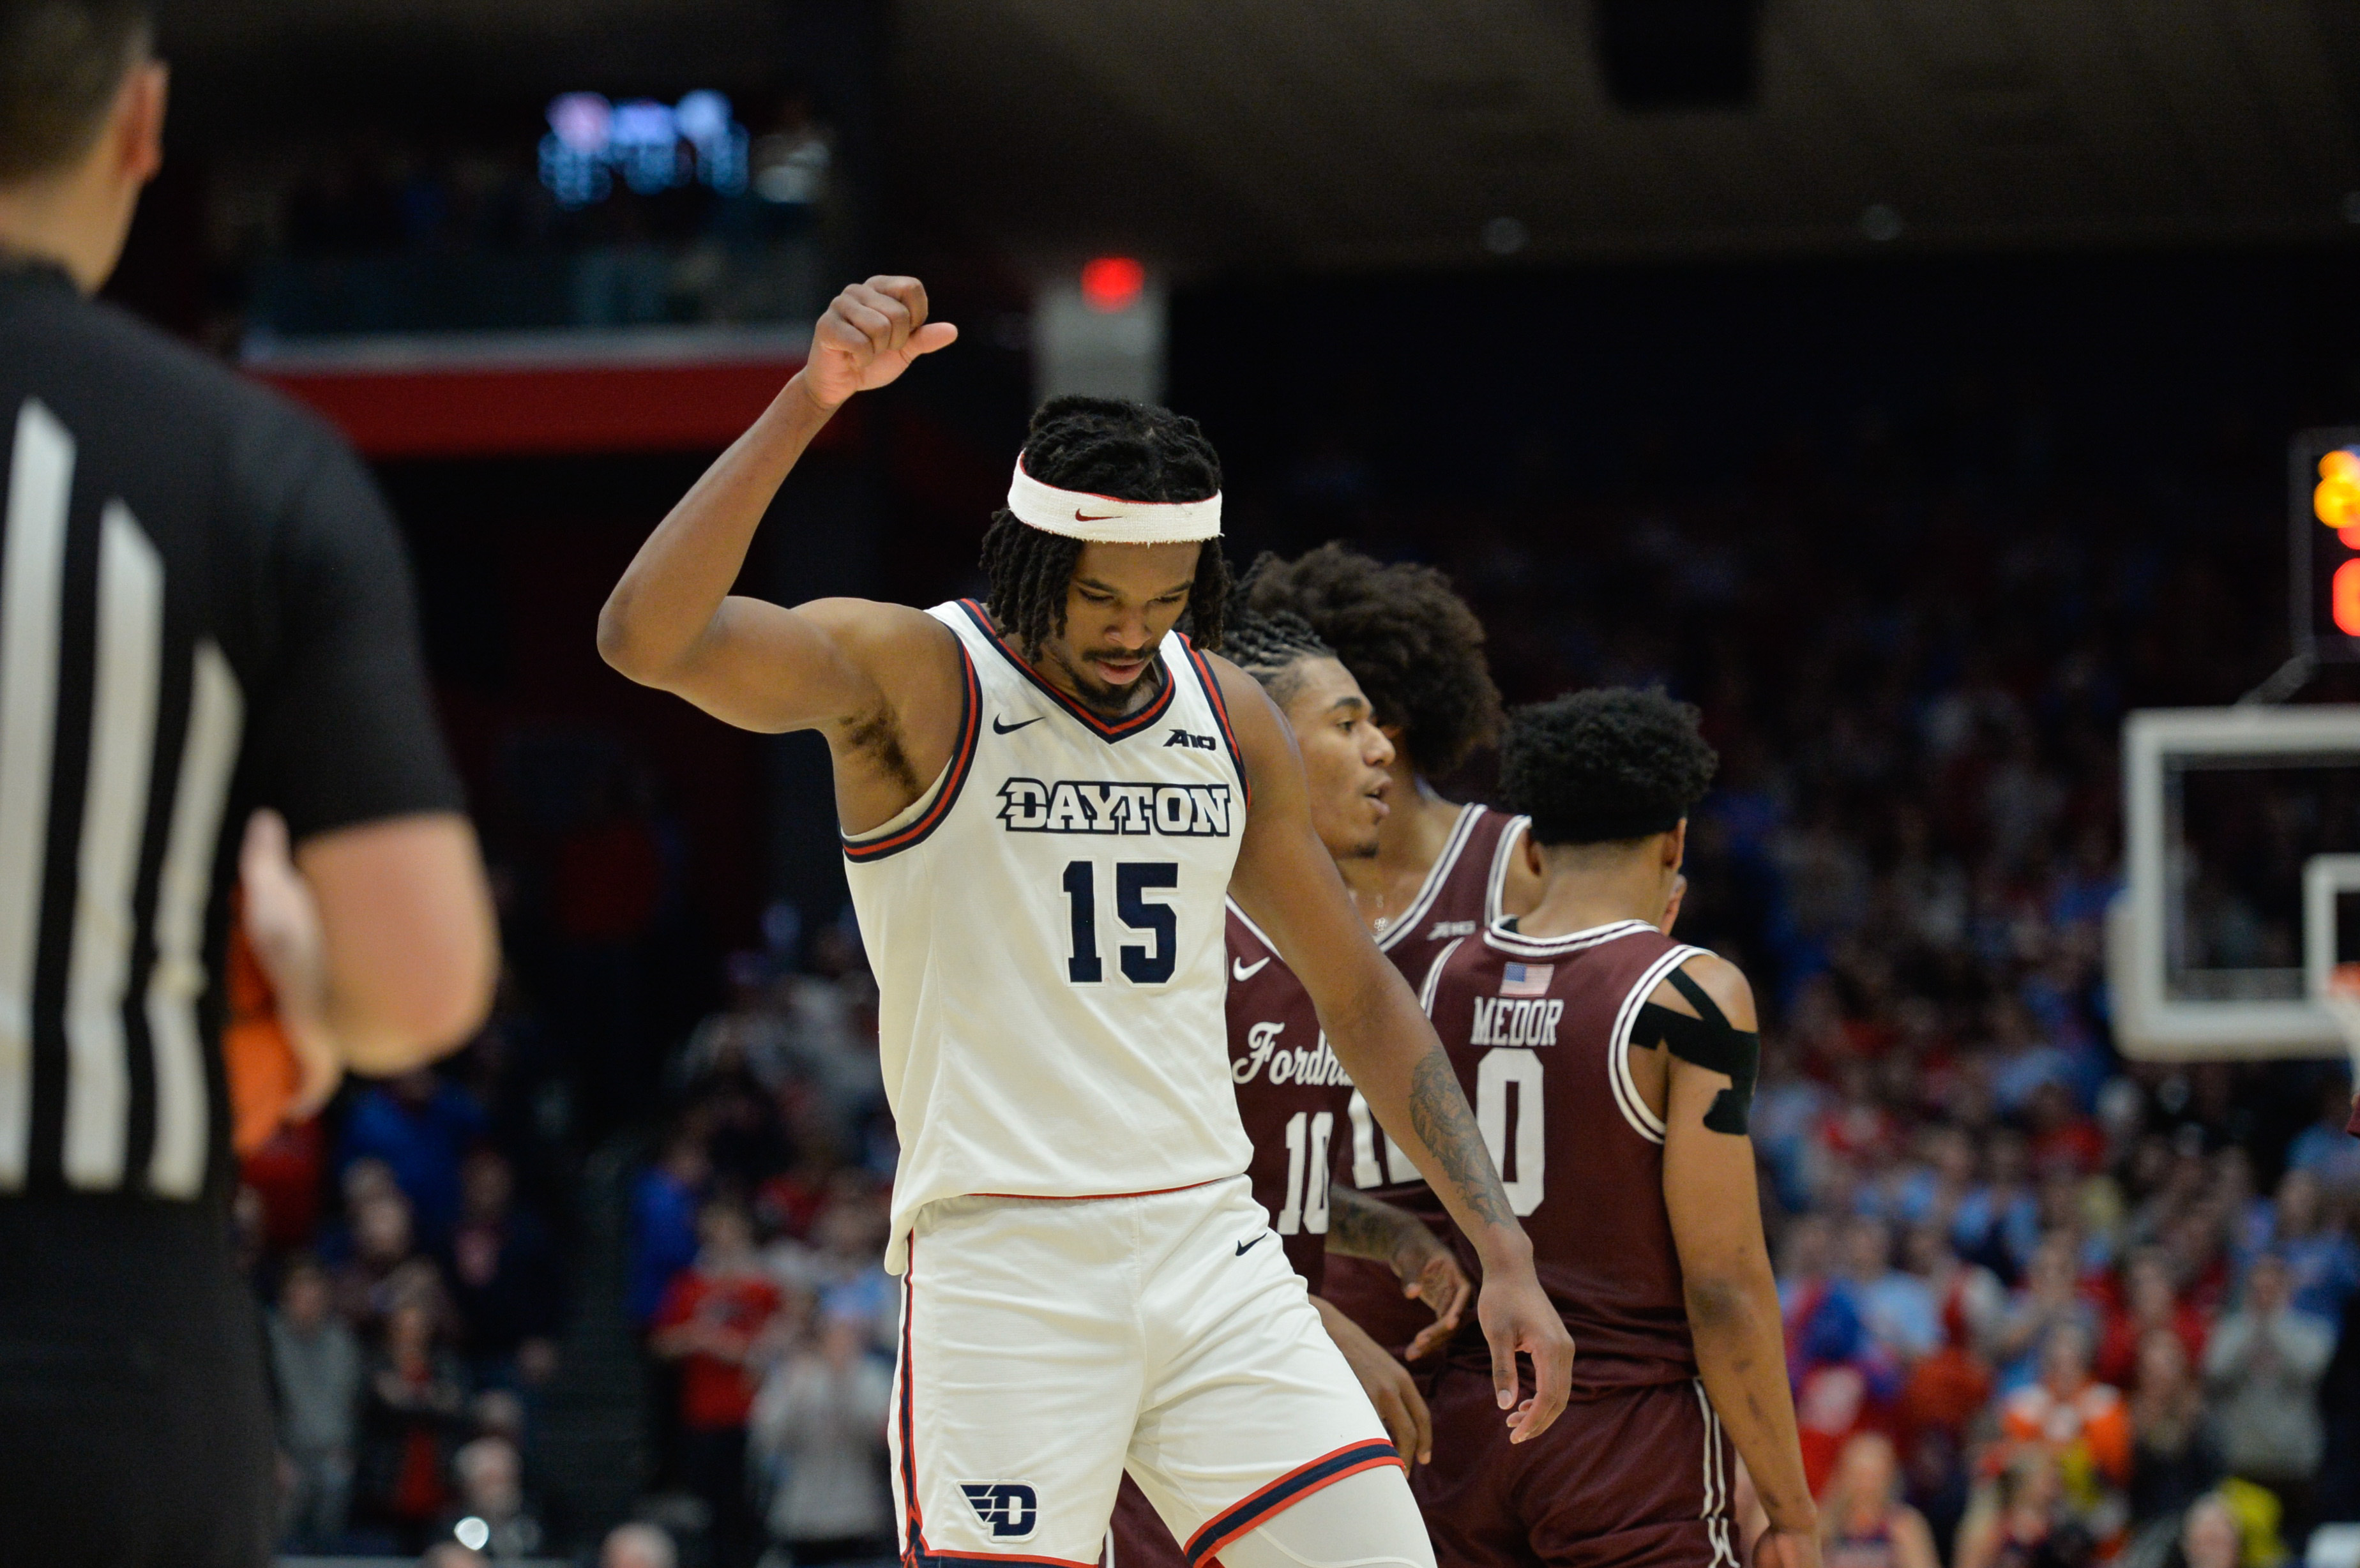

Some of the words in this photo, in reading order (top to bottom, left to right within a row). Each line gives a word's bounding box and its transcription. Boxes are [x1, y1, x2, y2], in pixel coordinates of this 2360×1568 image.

[1163, 729, 1216, 751] A10
[996, 777, 1230, 837] DAYTON
[1063, 860, 1178, 984] 15
[1469, 996, 1564, 1046] MEDOR
[1231, 1021, 1355, 1086] Fordh
[1476, 1048, 1545, 1217] 0
[1278, 1111, 1334, 1235] 10
[960, 1484, 1037, 1536] D
